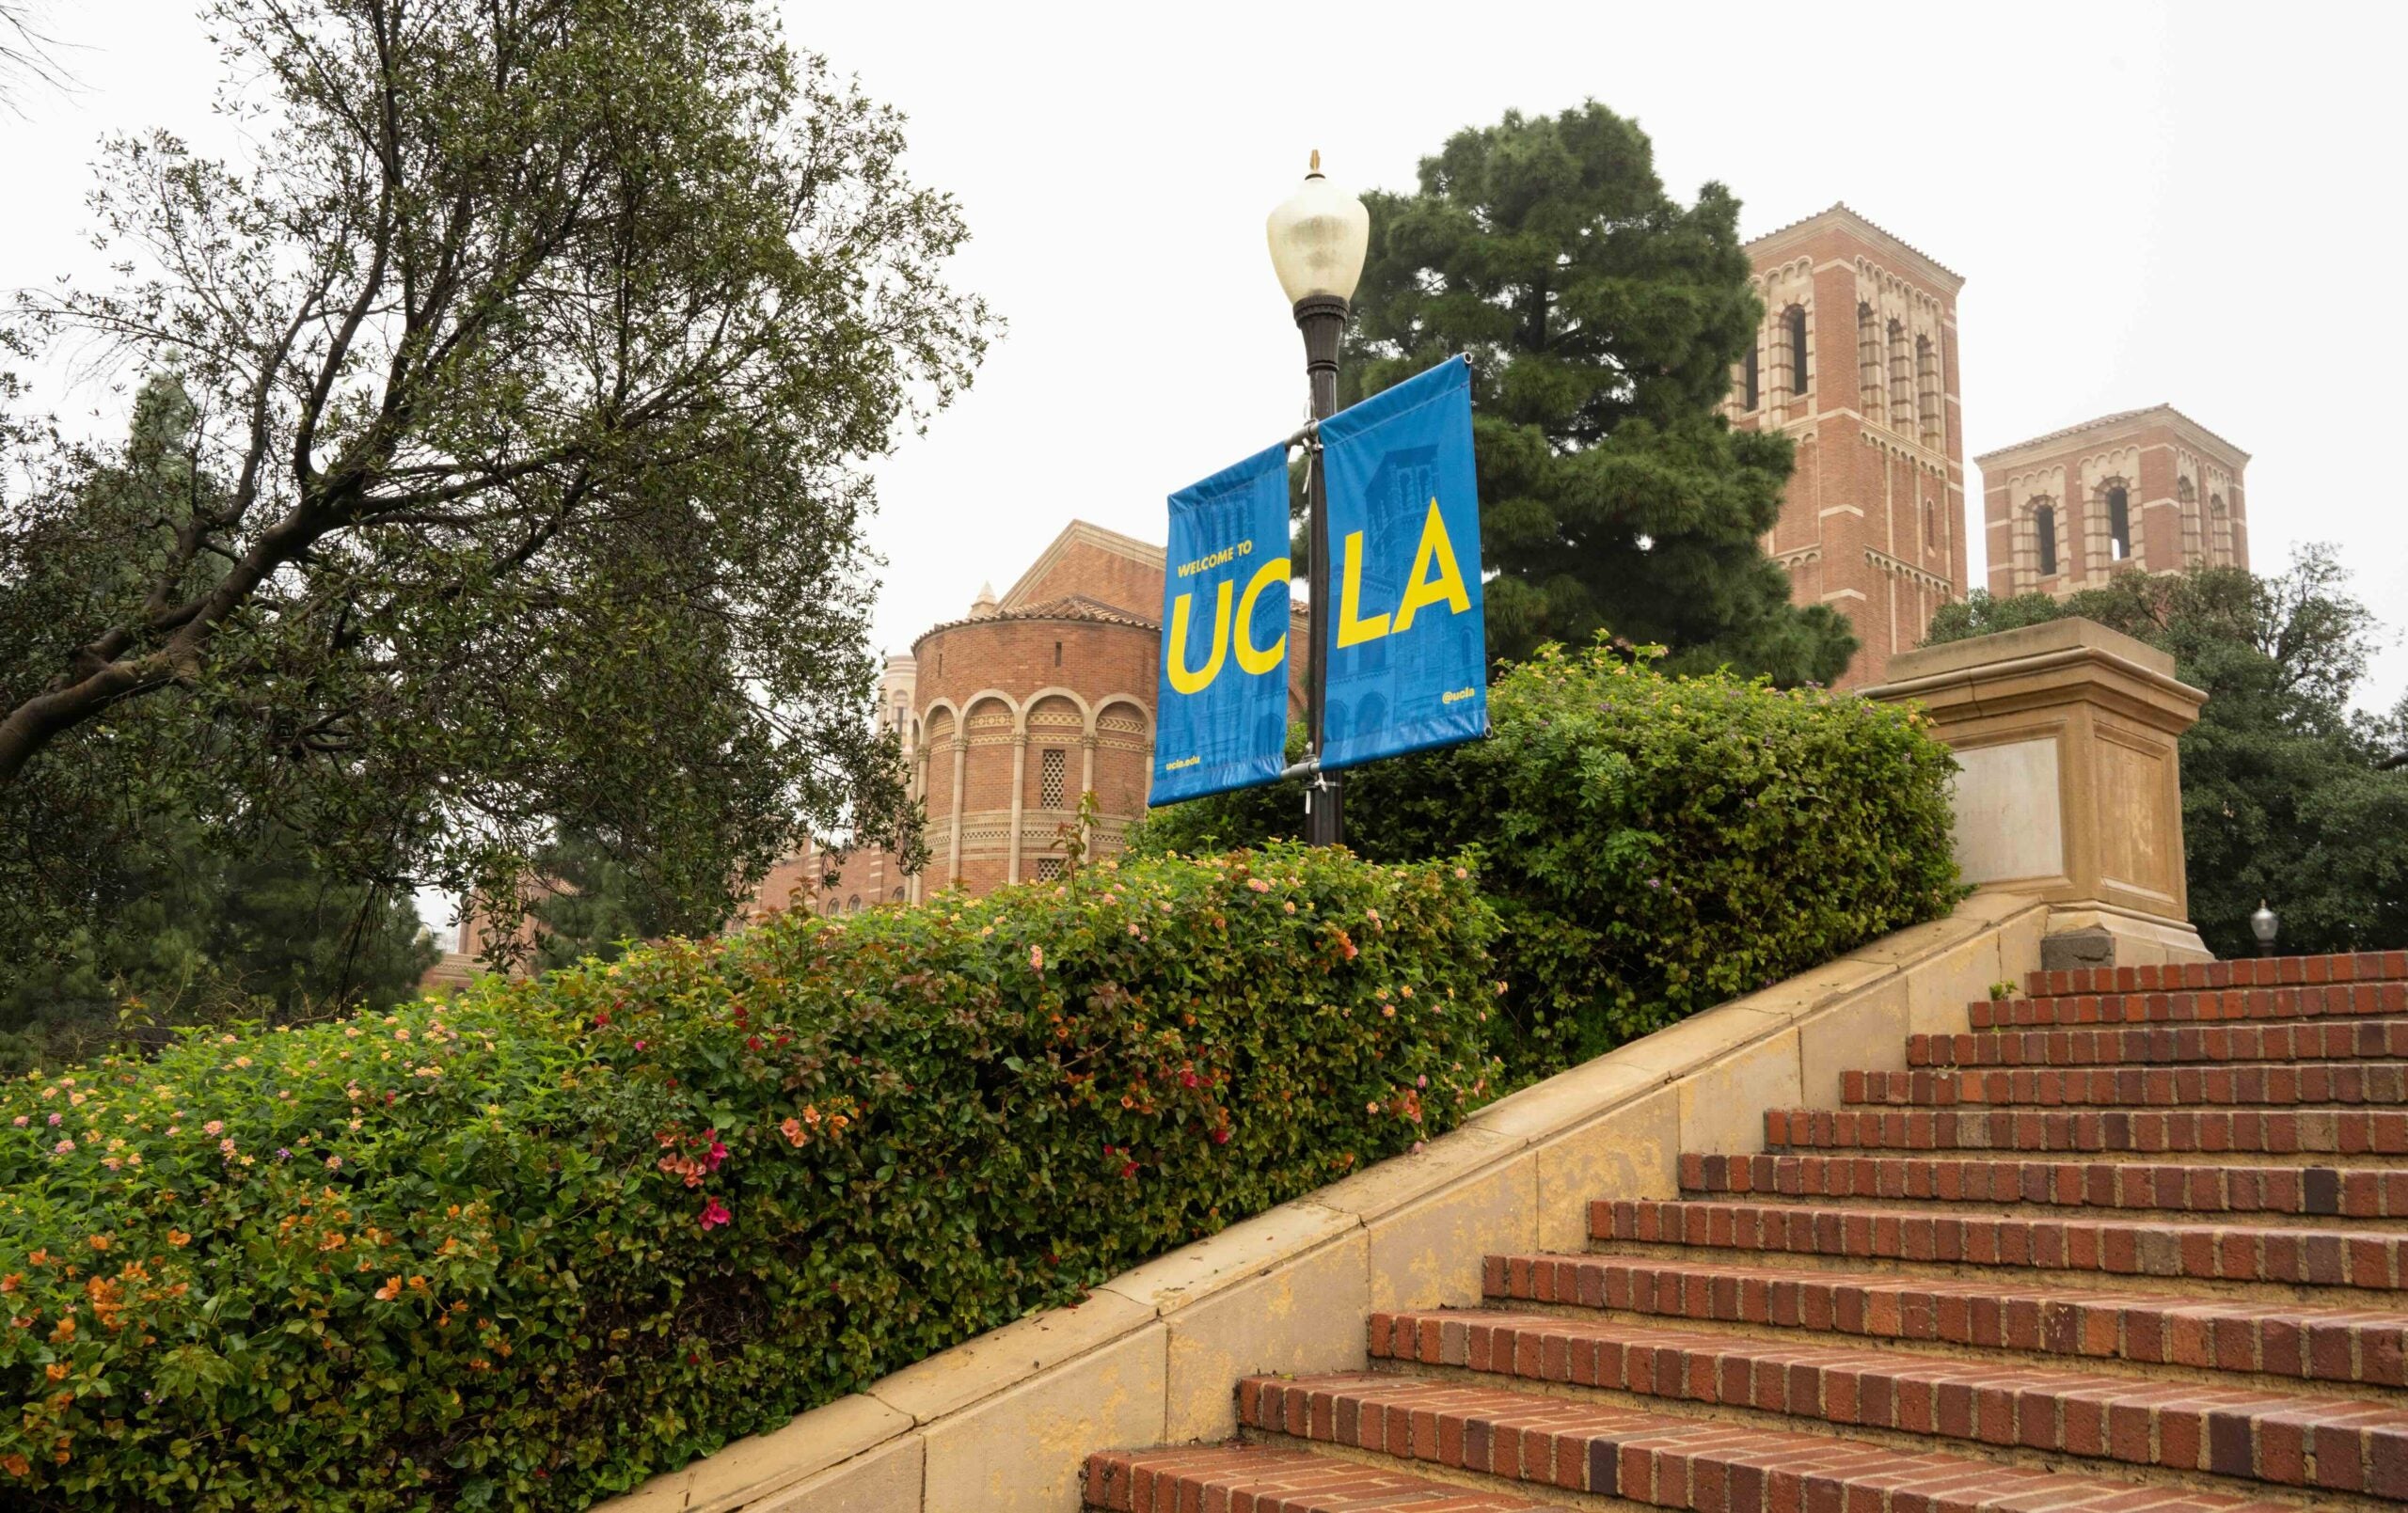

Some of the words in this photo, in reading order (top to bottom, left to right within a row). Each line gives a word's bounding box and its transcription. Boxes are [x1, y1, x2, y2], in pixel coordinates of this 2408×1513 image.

[1178, 546, 1234, 577] WELCOME
[1238, 540, 1252, 556] TO
[1442, 686, 1475, 704] @ucla
[1165, 755, 1200, 770] ucla.edu
